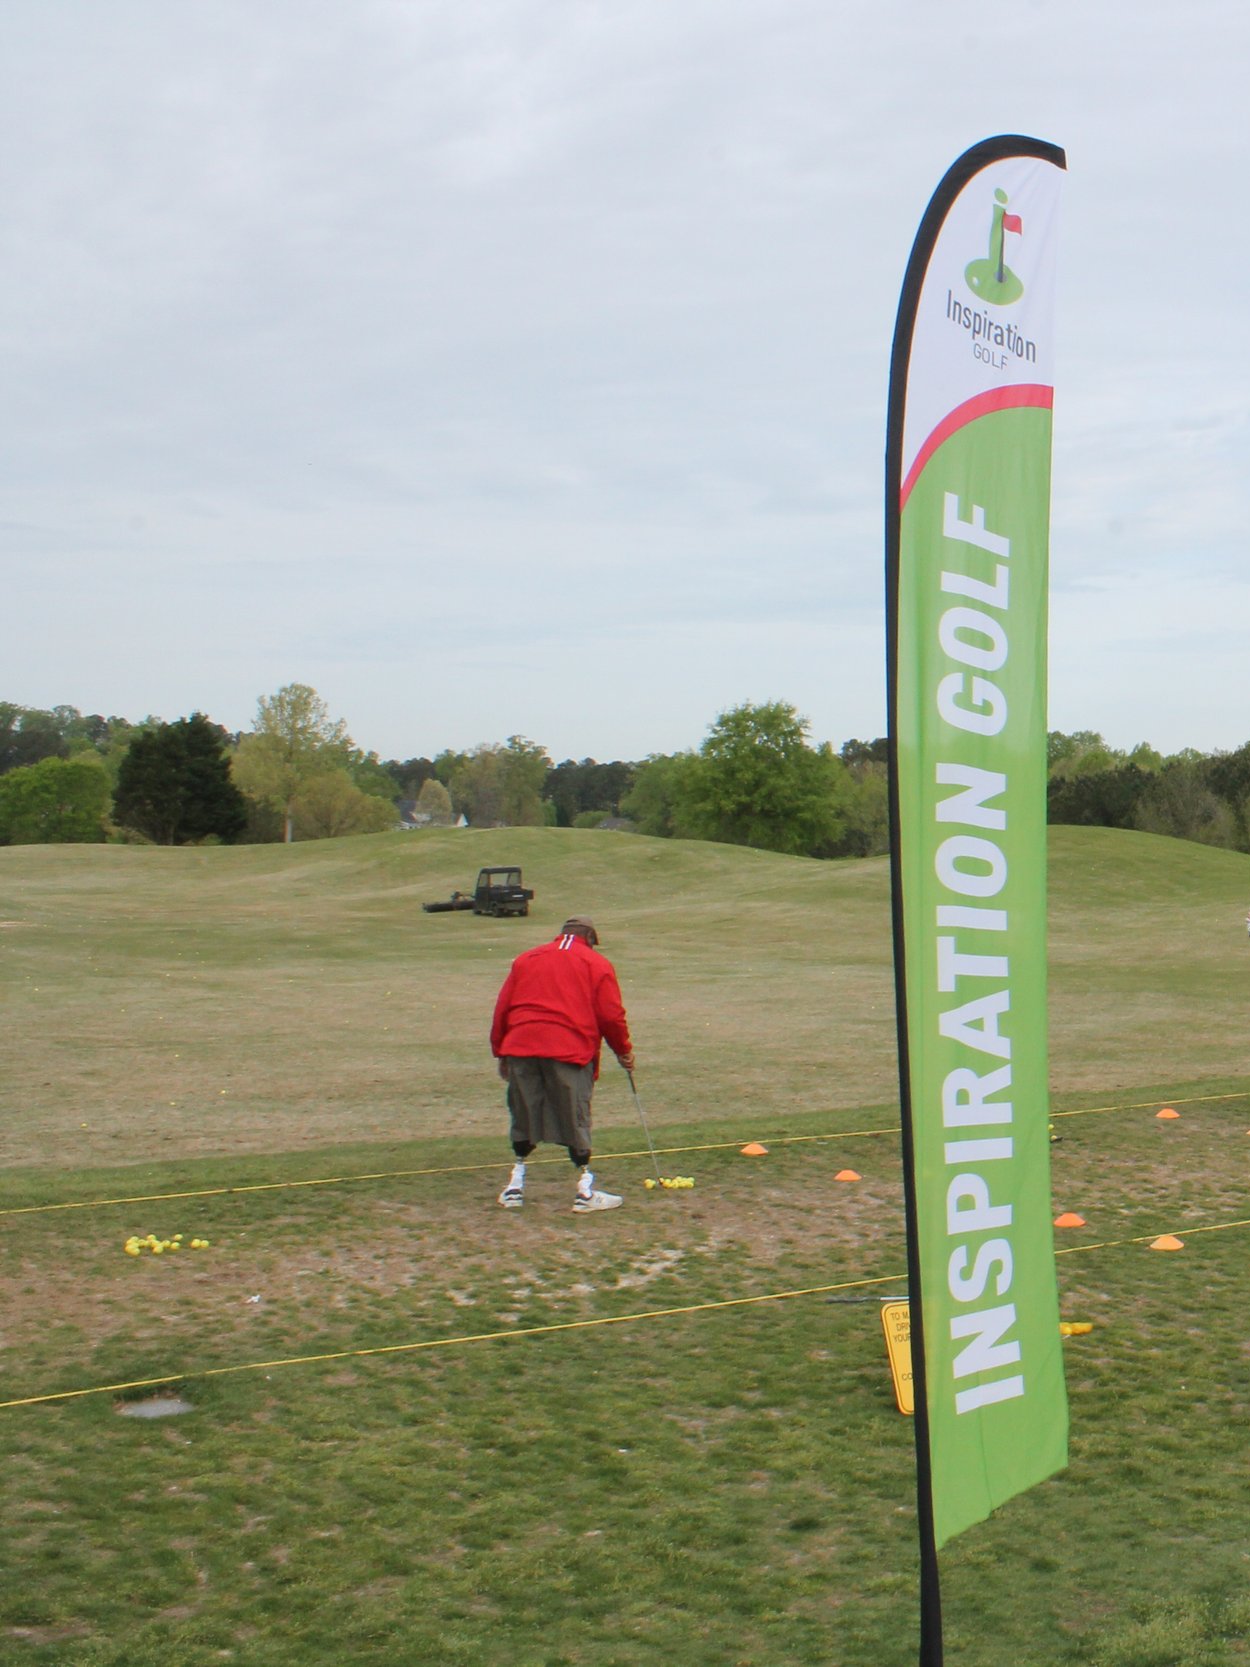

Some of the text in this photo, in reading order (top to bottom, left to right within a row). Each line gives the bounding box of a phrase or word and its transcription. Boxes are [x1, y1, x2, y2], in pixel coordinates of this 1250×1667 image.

[946, 289, 1037, 363] Inspiration
[973, 343, 1008, 370] GOLF
[935, 491, 1025, 1415] INSPIRATION GOLF
